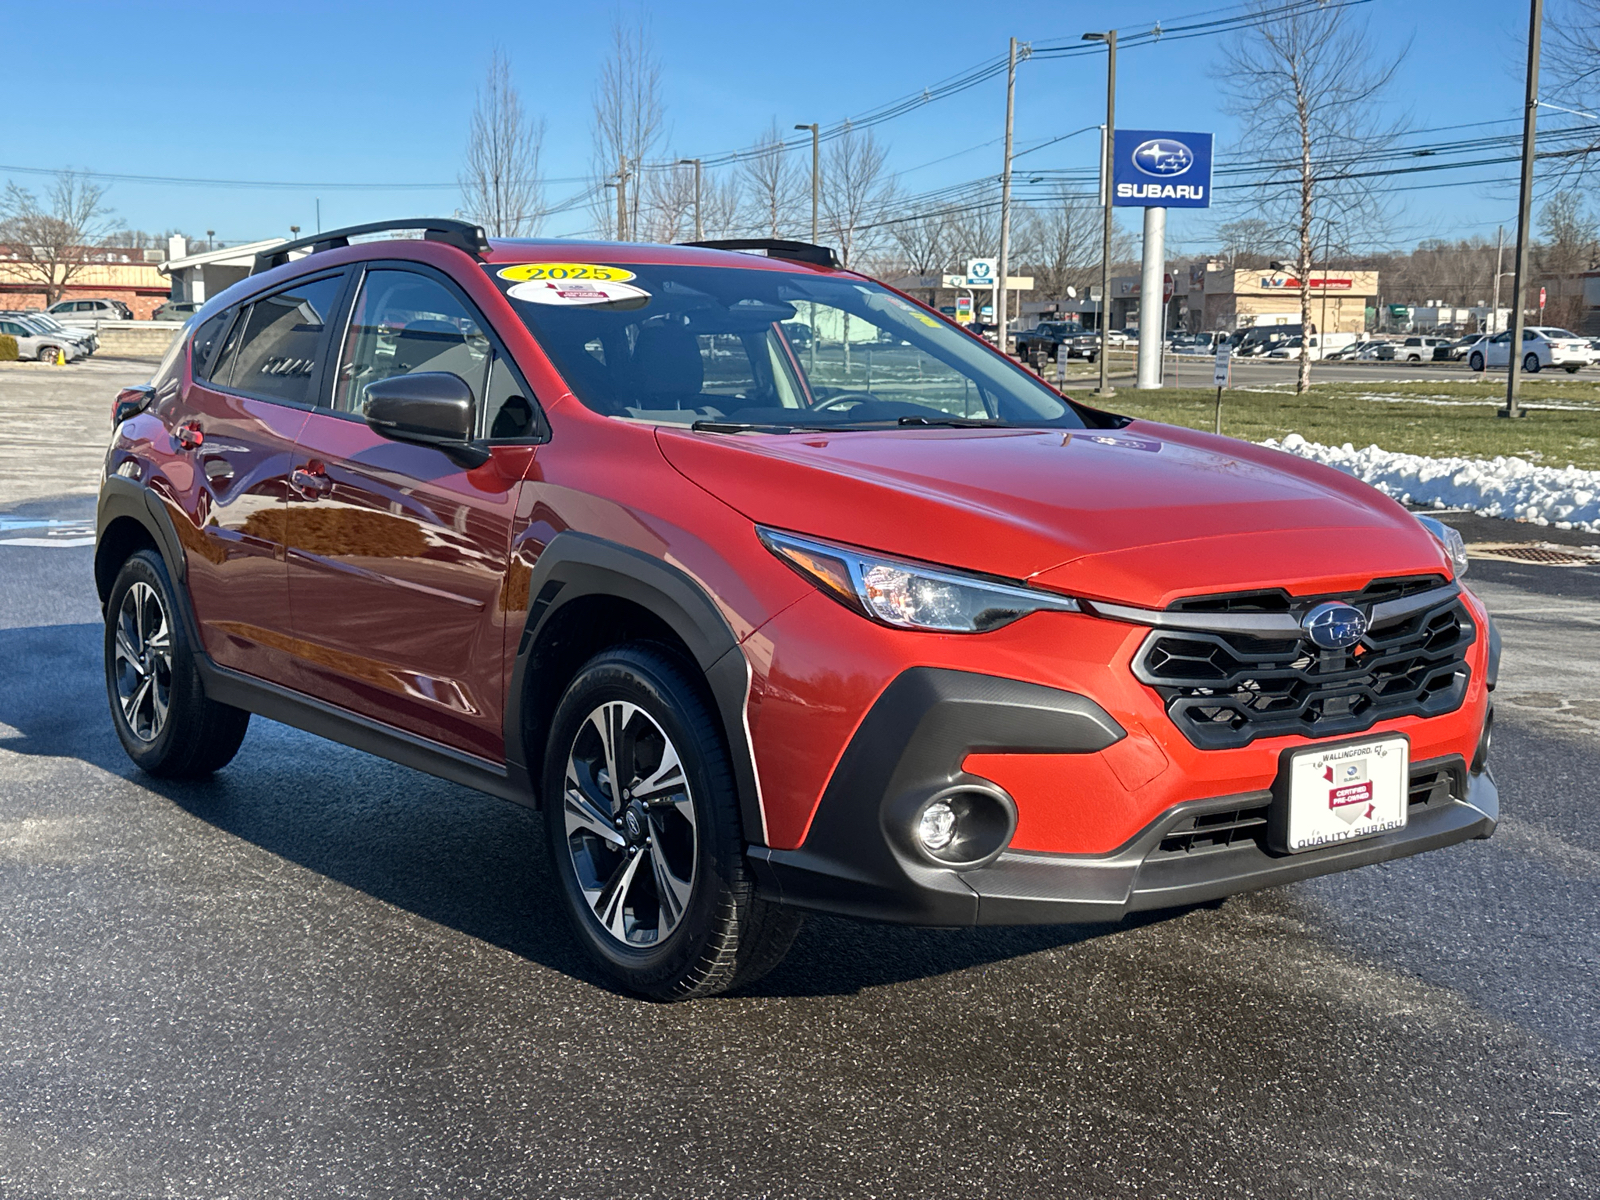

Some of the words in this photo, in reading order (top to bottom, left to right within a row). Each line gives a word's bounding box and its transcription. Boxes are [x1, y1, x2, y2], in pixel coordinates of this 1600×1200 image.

[1117, 183, 1203, 199] SUBARU
[526, 268, 611, 280] 2025
[1336, 785, 1367, 797] CERTIFIED
[1333, 792, 1369, 805] PRE-OWNED
[1298, 830, 1350, 848] QUALITY
[1354, 819, 1403, 836] SUBARU
